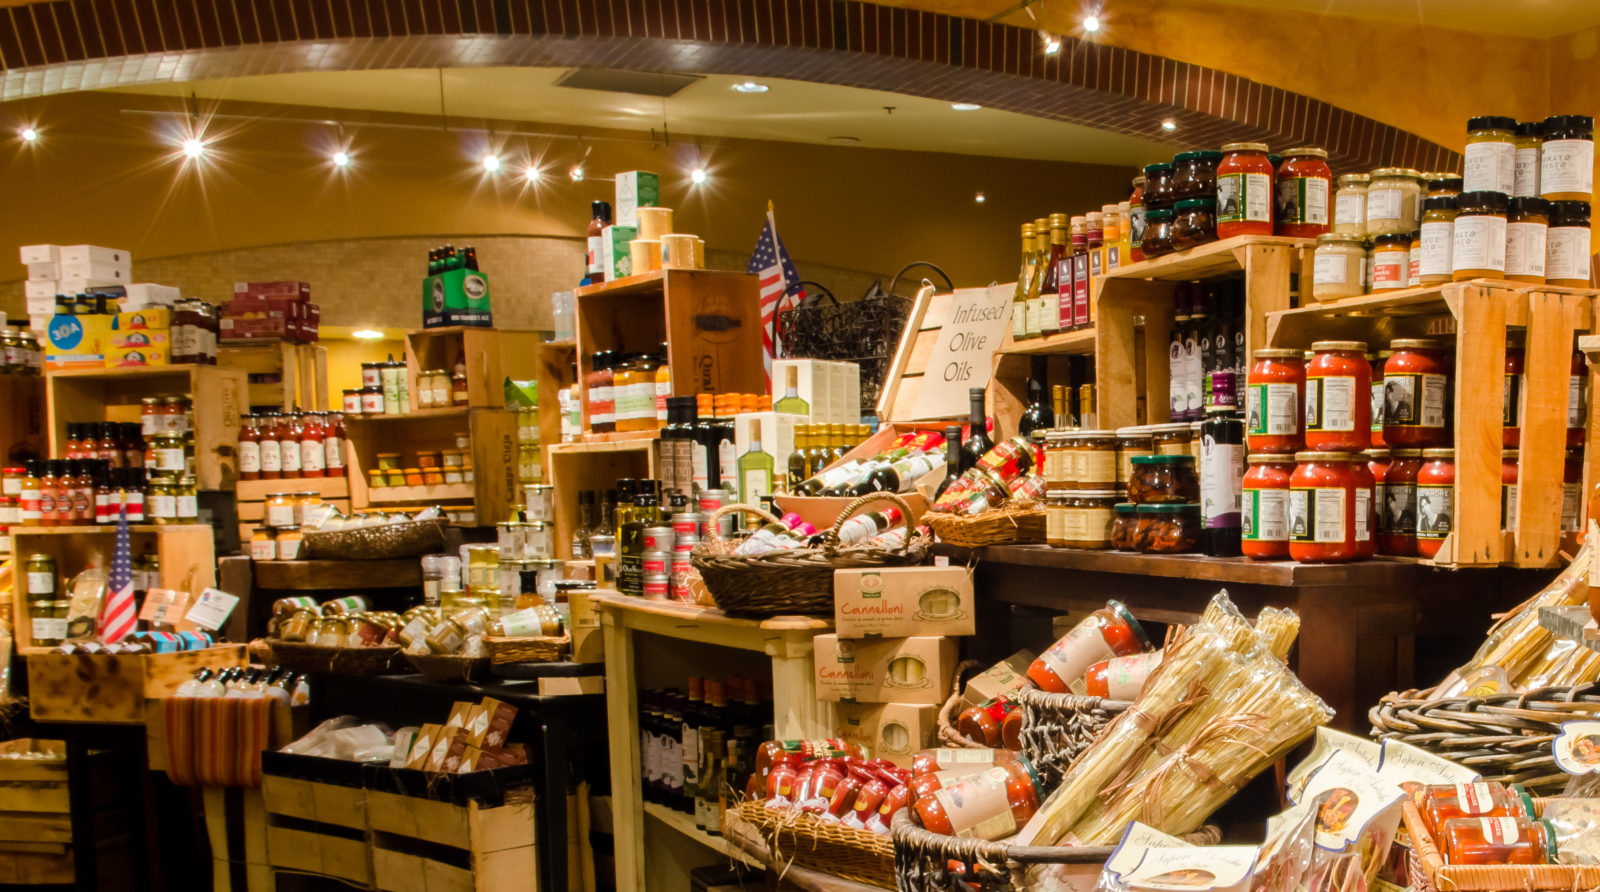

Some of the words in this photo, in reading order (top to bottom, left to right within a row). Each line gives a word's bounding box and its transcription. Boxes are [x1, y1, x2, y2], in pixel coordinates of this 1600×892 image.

[953, 300, 1007, 324] Infused
[949, 331, 987, 352] Olive
[943, 361, 973, 382] Oils
[841, 600, 903, 615] Cannelloni
[819, 664, 874, 679] Cannelloni
